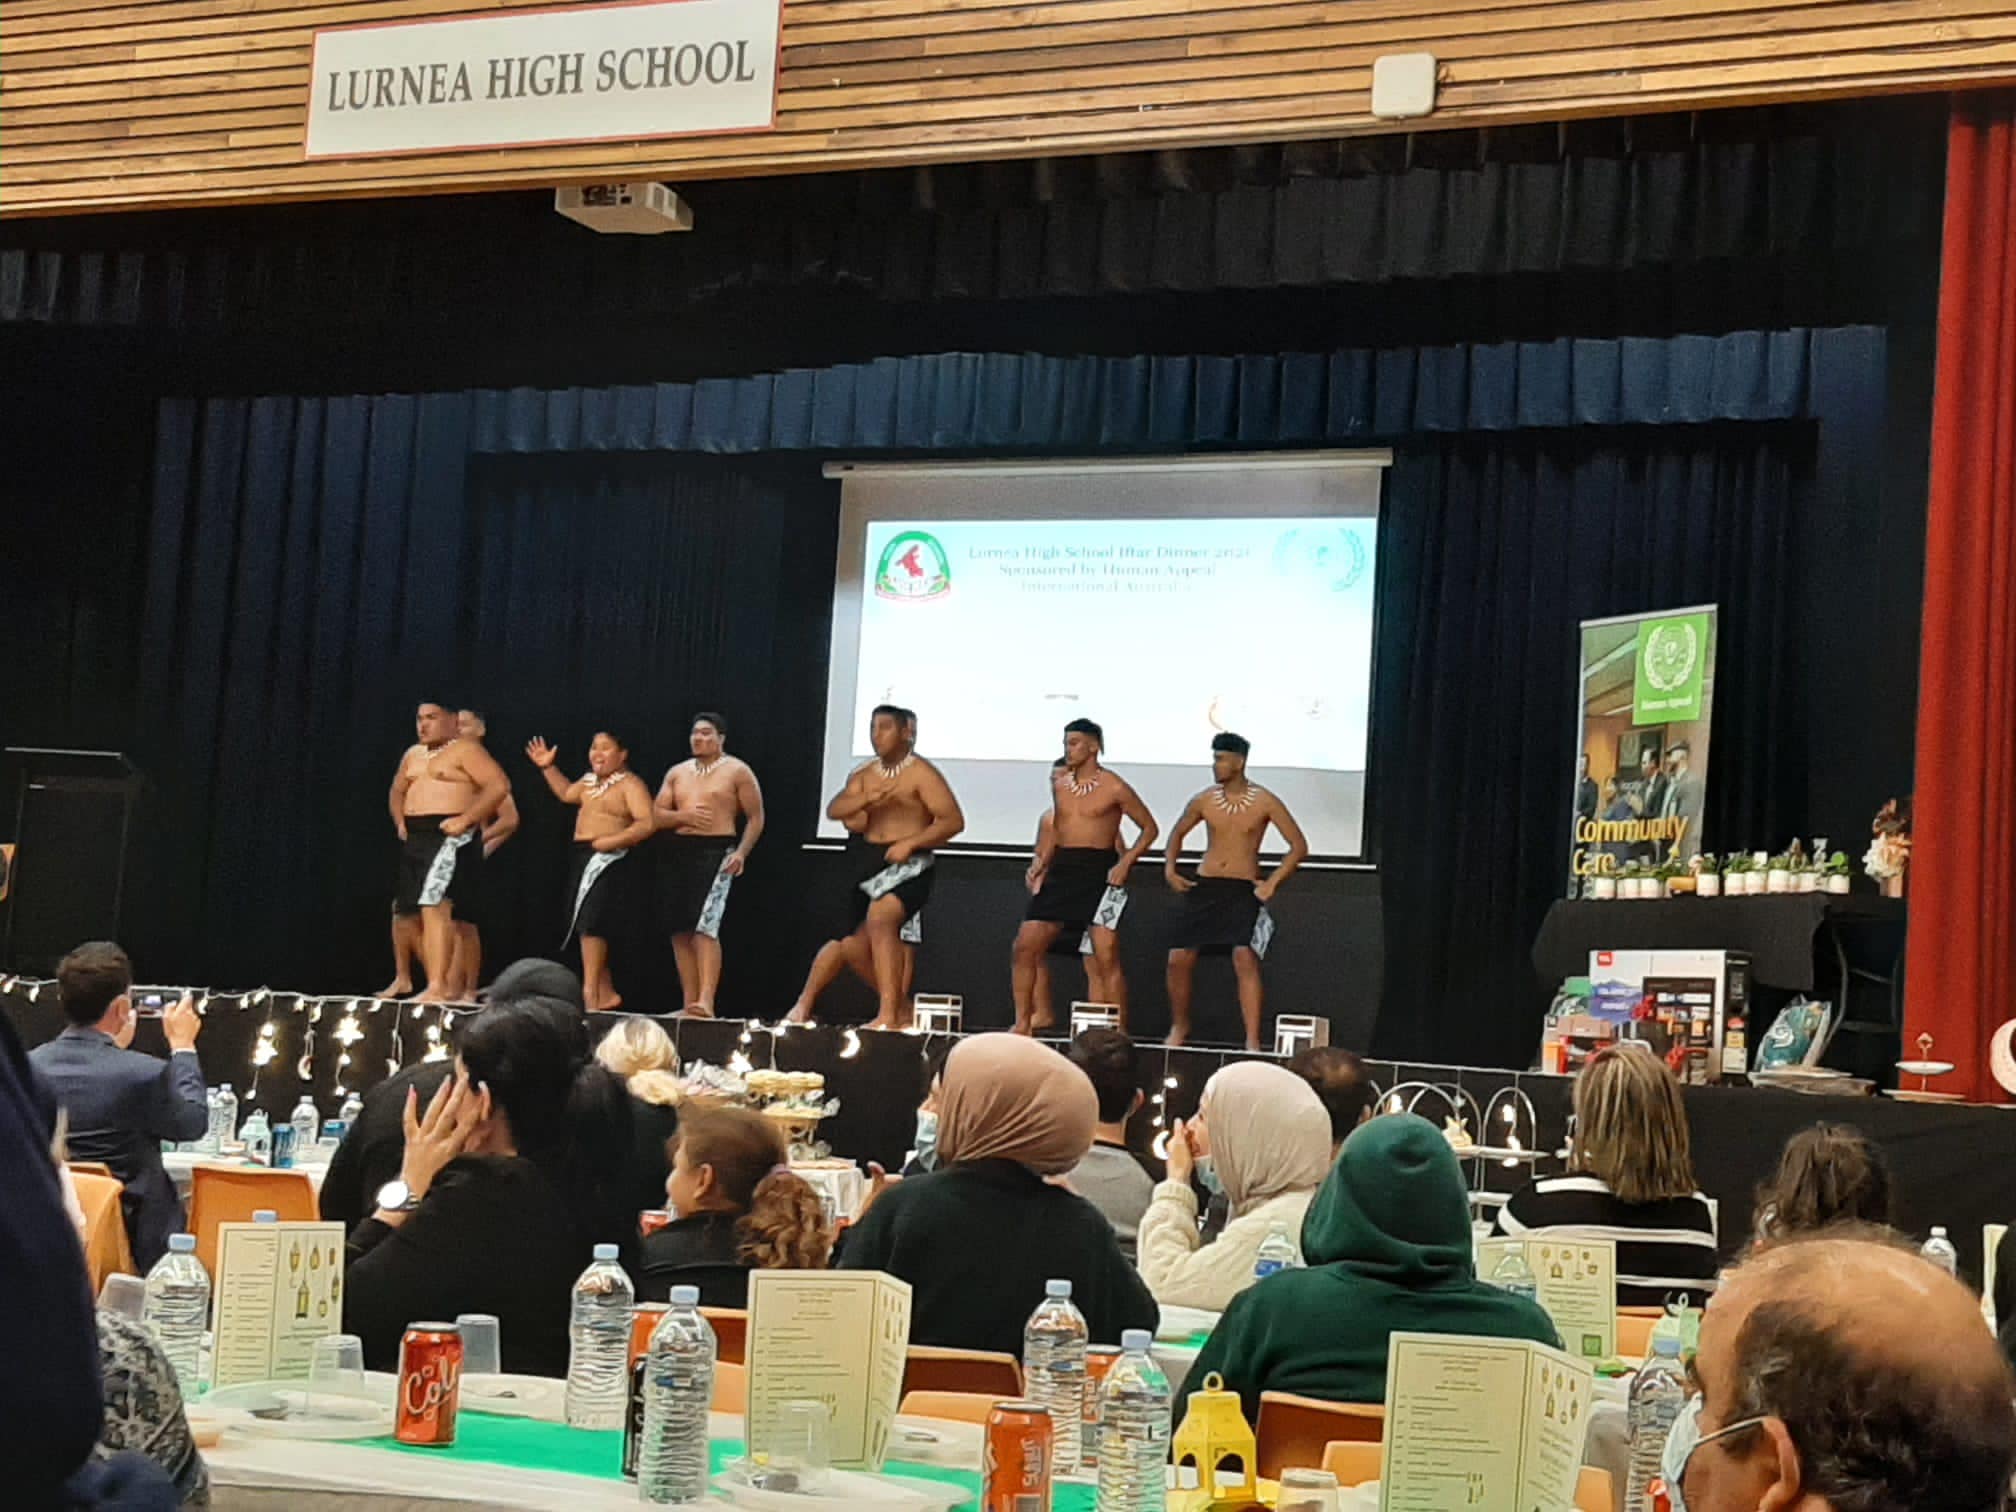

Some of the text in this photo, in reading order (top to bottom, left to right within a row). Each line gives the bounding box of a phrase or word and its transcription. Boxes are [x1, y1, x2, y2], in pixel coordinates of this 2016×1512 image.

[328, 39, 756, 111] LURNEA HIGH SCHOOL
[1025, 546, 1060, 560] High
[1065, 545, 1114, 559] School
[1157, 545, 1209, 558] Dinner
[1000, 563, 1077, 576] Sponsored
[1081, 563, 1097, 576] by
[1103, 563, 1161, 576] Human
[1575, 815, 1689, 843] Community
[1573, 848, 1616, 875] Care
